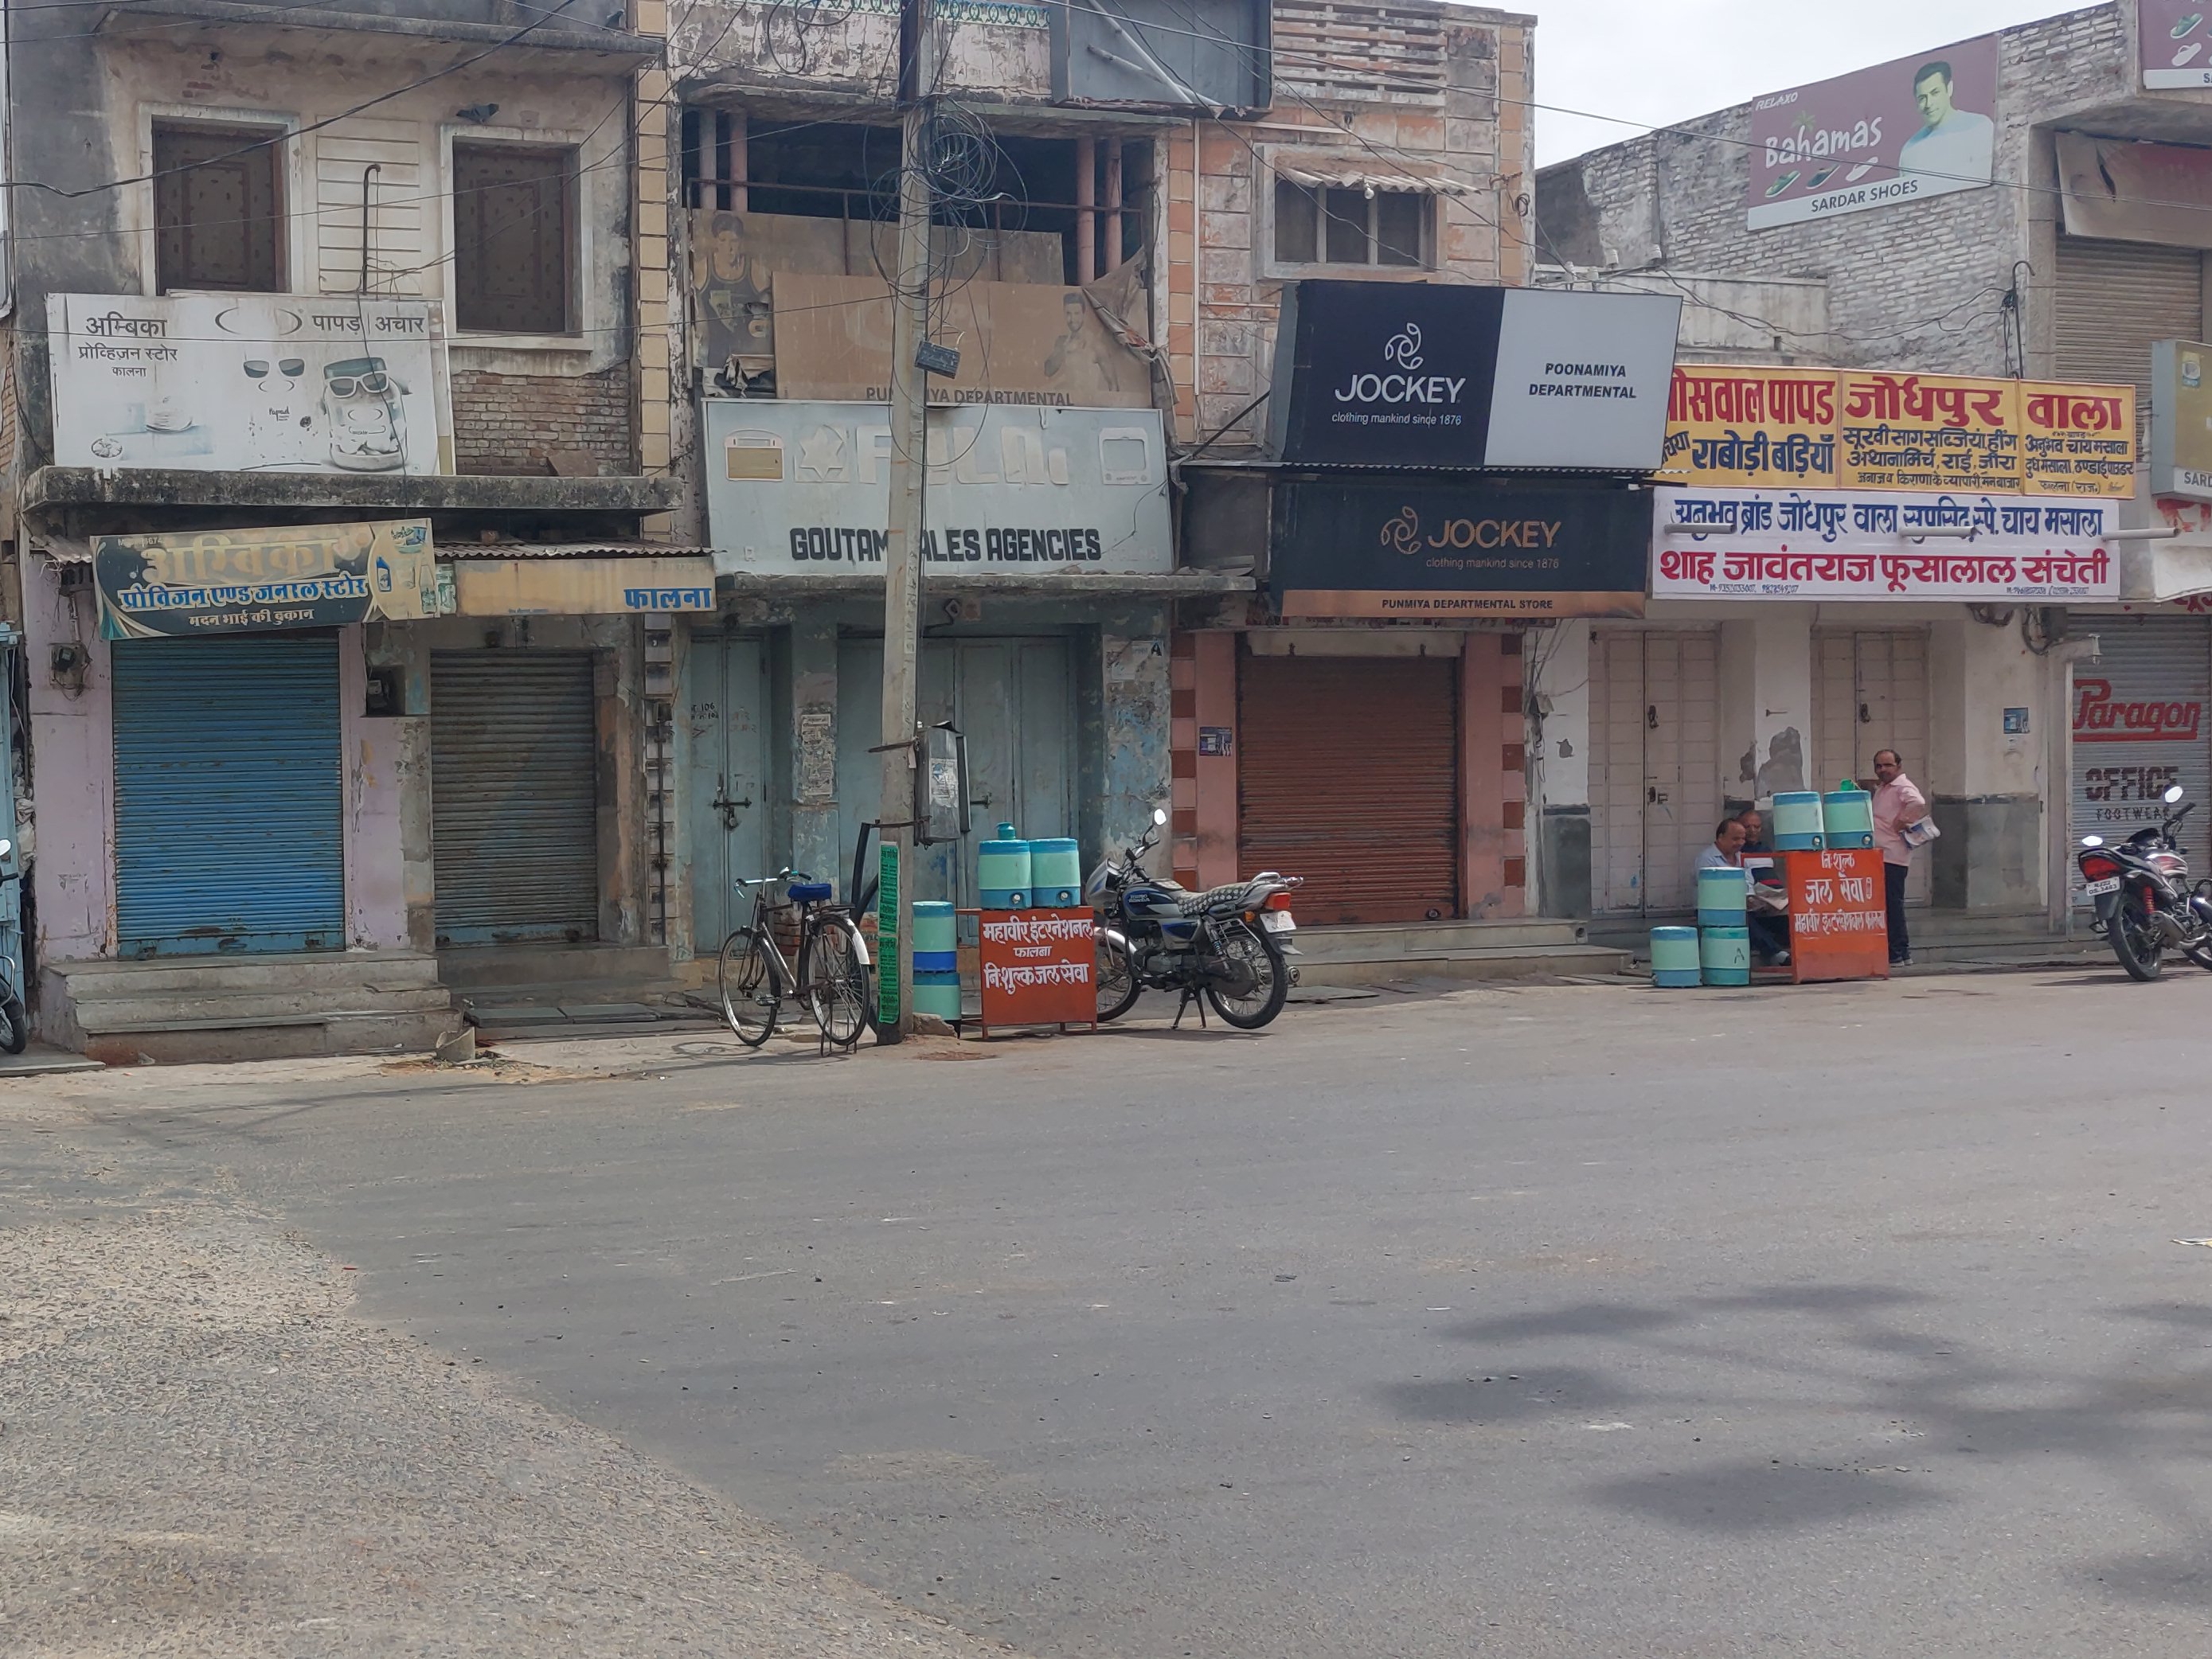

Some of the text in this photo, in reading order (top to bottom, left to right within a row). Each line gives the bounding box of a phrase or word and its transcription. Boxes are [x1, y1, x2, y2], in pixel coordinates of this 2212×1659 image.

[1755, 92, 1798, 111] RELAXO
[1765, 117, 1882, 169] Bahamas
[1811, 180, 1918, 213] SARDAR SHOES
[85, 310, 167, 338] अम्बिका
[311, 315, 424, 335] पापड़ अचार
[144, 344, 178, 361] स्टोर
[1545, 362, 1626, 378] POONAMIYA
[954, 388, 1073, 406] DEPARTMENTAL
[1335, 373, 1466, 404] JOCKEY
[1528, 384, 1637, 399] DEPARTMENTAL
[1845, 375, 2004, 427] जोधपुर
[1331, 412, 1462, 427] clothing mankind since 1876
[2026, 393, 2123, 431] वाला
[1777, 493, 1848, 543] जोधपुर
[1852, 503, 1898, 534] वाला
[2000, 506, 2042, 535] चाय
[2045, 507, 2104, 537] मसाला
[920, 529, 981, 561] ALES
[985, 529, 1102, 561] AGENCIES
[1428, 519, 1561, 548] JOCKEY
[1426, 557, 1559, 571] clothing mankind since 1876
[1660, 544, 2111, 592] शाह जावंतराज फूसालाल संचेती
[623, 587, 712, 610] फालना
[1382, 599, 1553, 610] PUNMIYA DEPARTMENTAL STORE
[2073, 679, 2202, 742] Paragon
[1805, 872, 1865, 905] जल सेवा
[983, 913, 1094, 945] महावीर इंटरनेशनल
[1034, 964, 1061, 986] जल
[1059, 958, 1089, 985] सेवा
